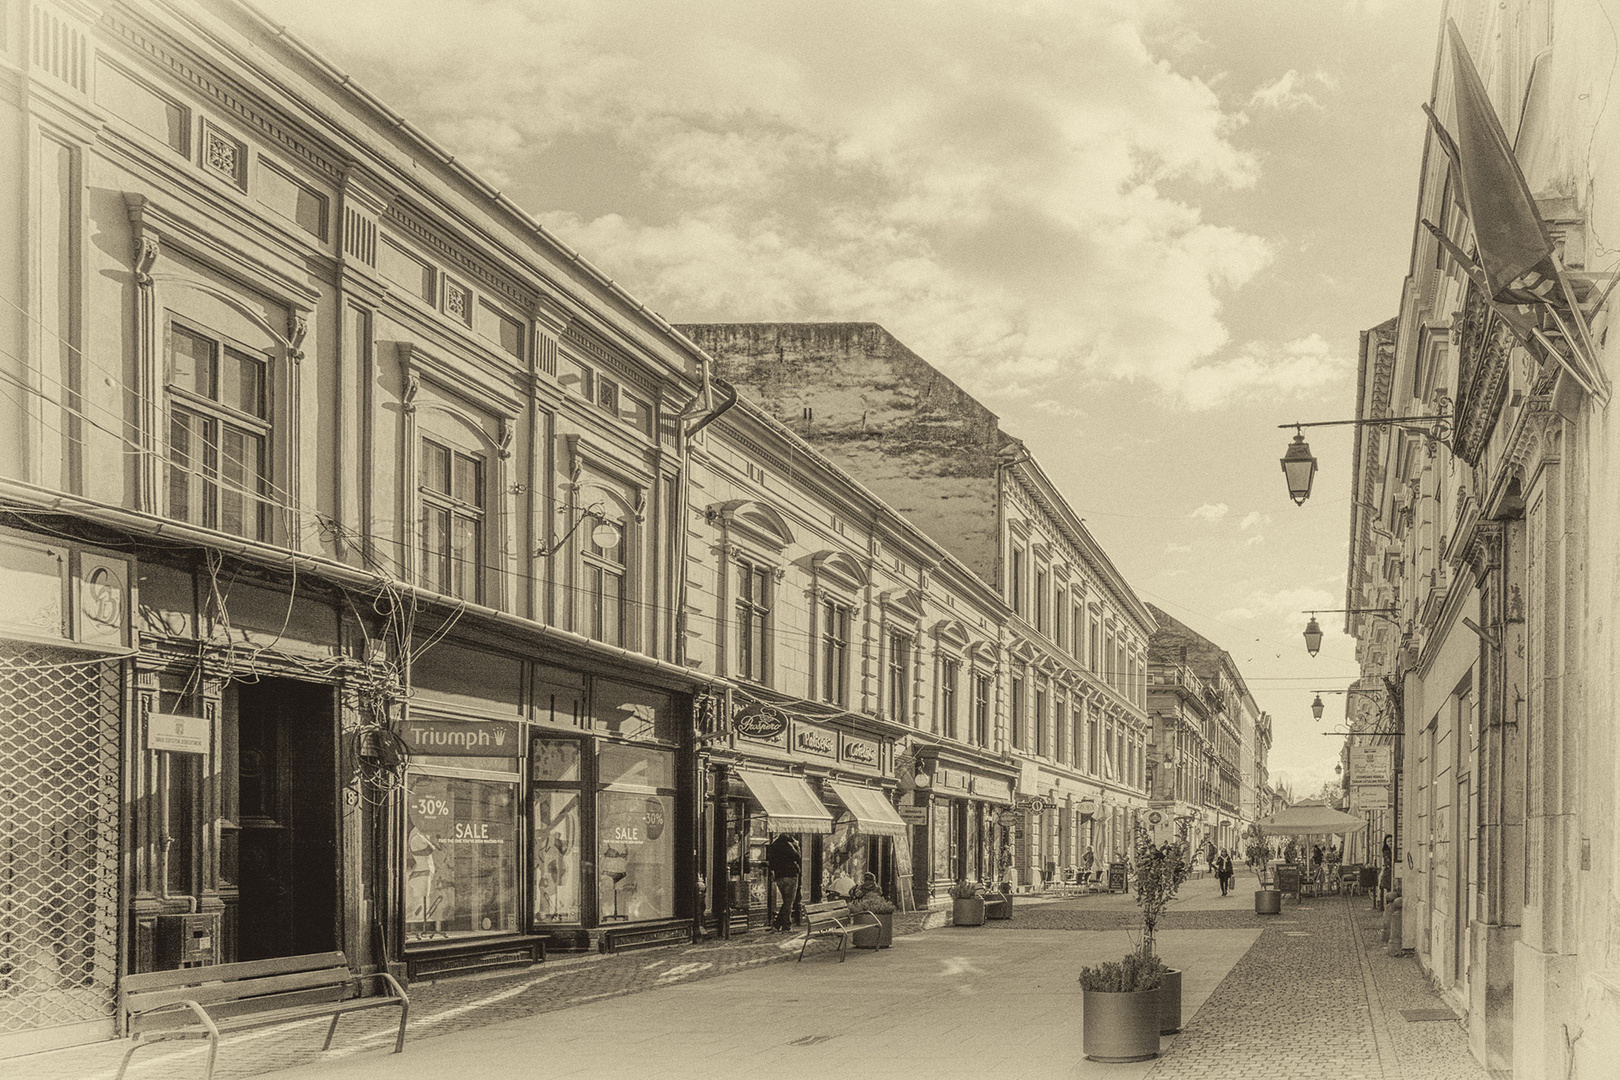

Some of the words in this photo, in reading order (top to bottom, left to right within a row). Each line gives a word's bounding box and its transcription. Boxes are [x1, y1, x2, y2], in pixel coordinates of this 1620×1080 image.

[738, 715, 782, 733] Prospero
[410, 727, 490, 750] Triumph
[347, 791, 354, 805] 8
[412, 799, 449, 815] -30%
[642, 813, 664, 825] -30%
[455, 823, 489, 838] SALE
[615, 827, 638, 840] SALE
